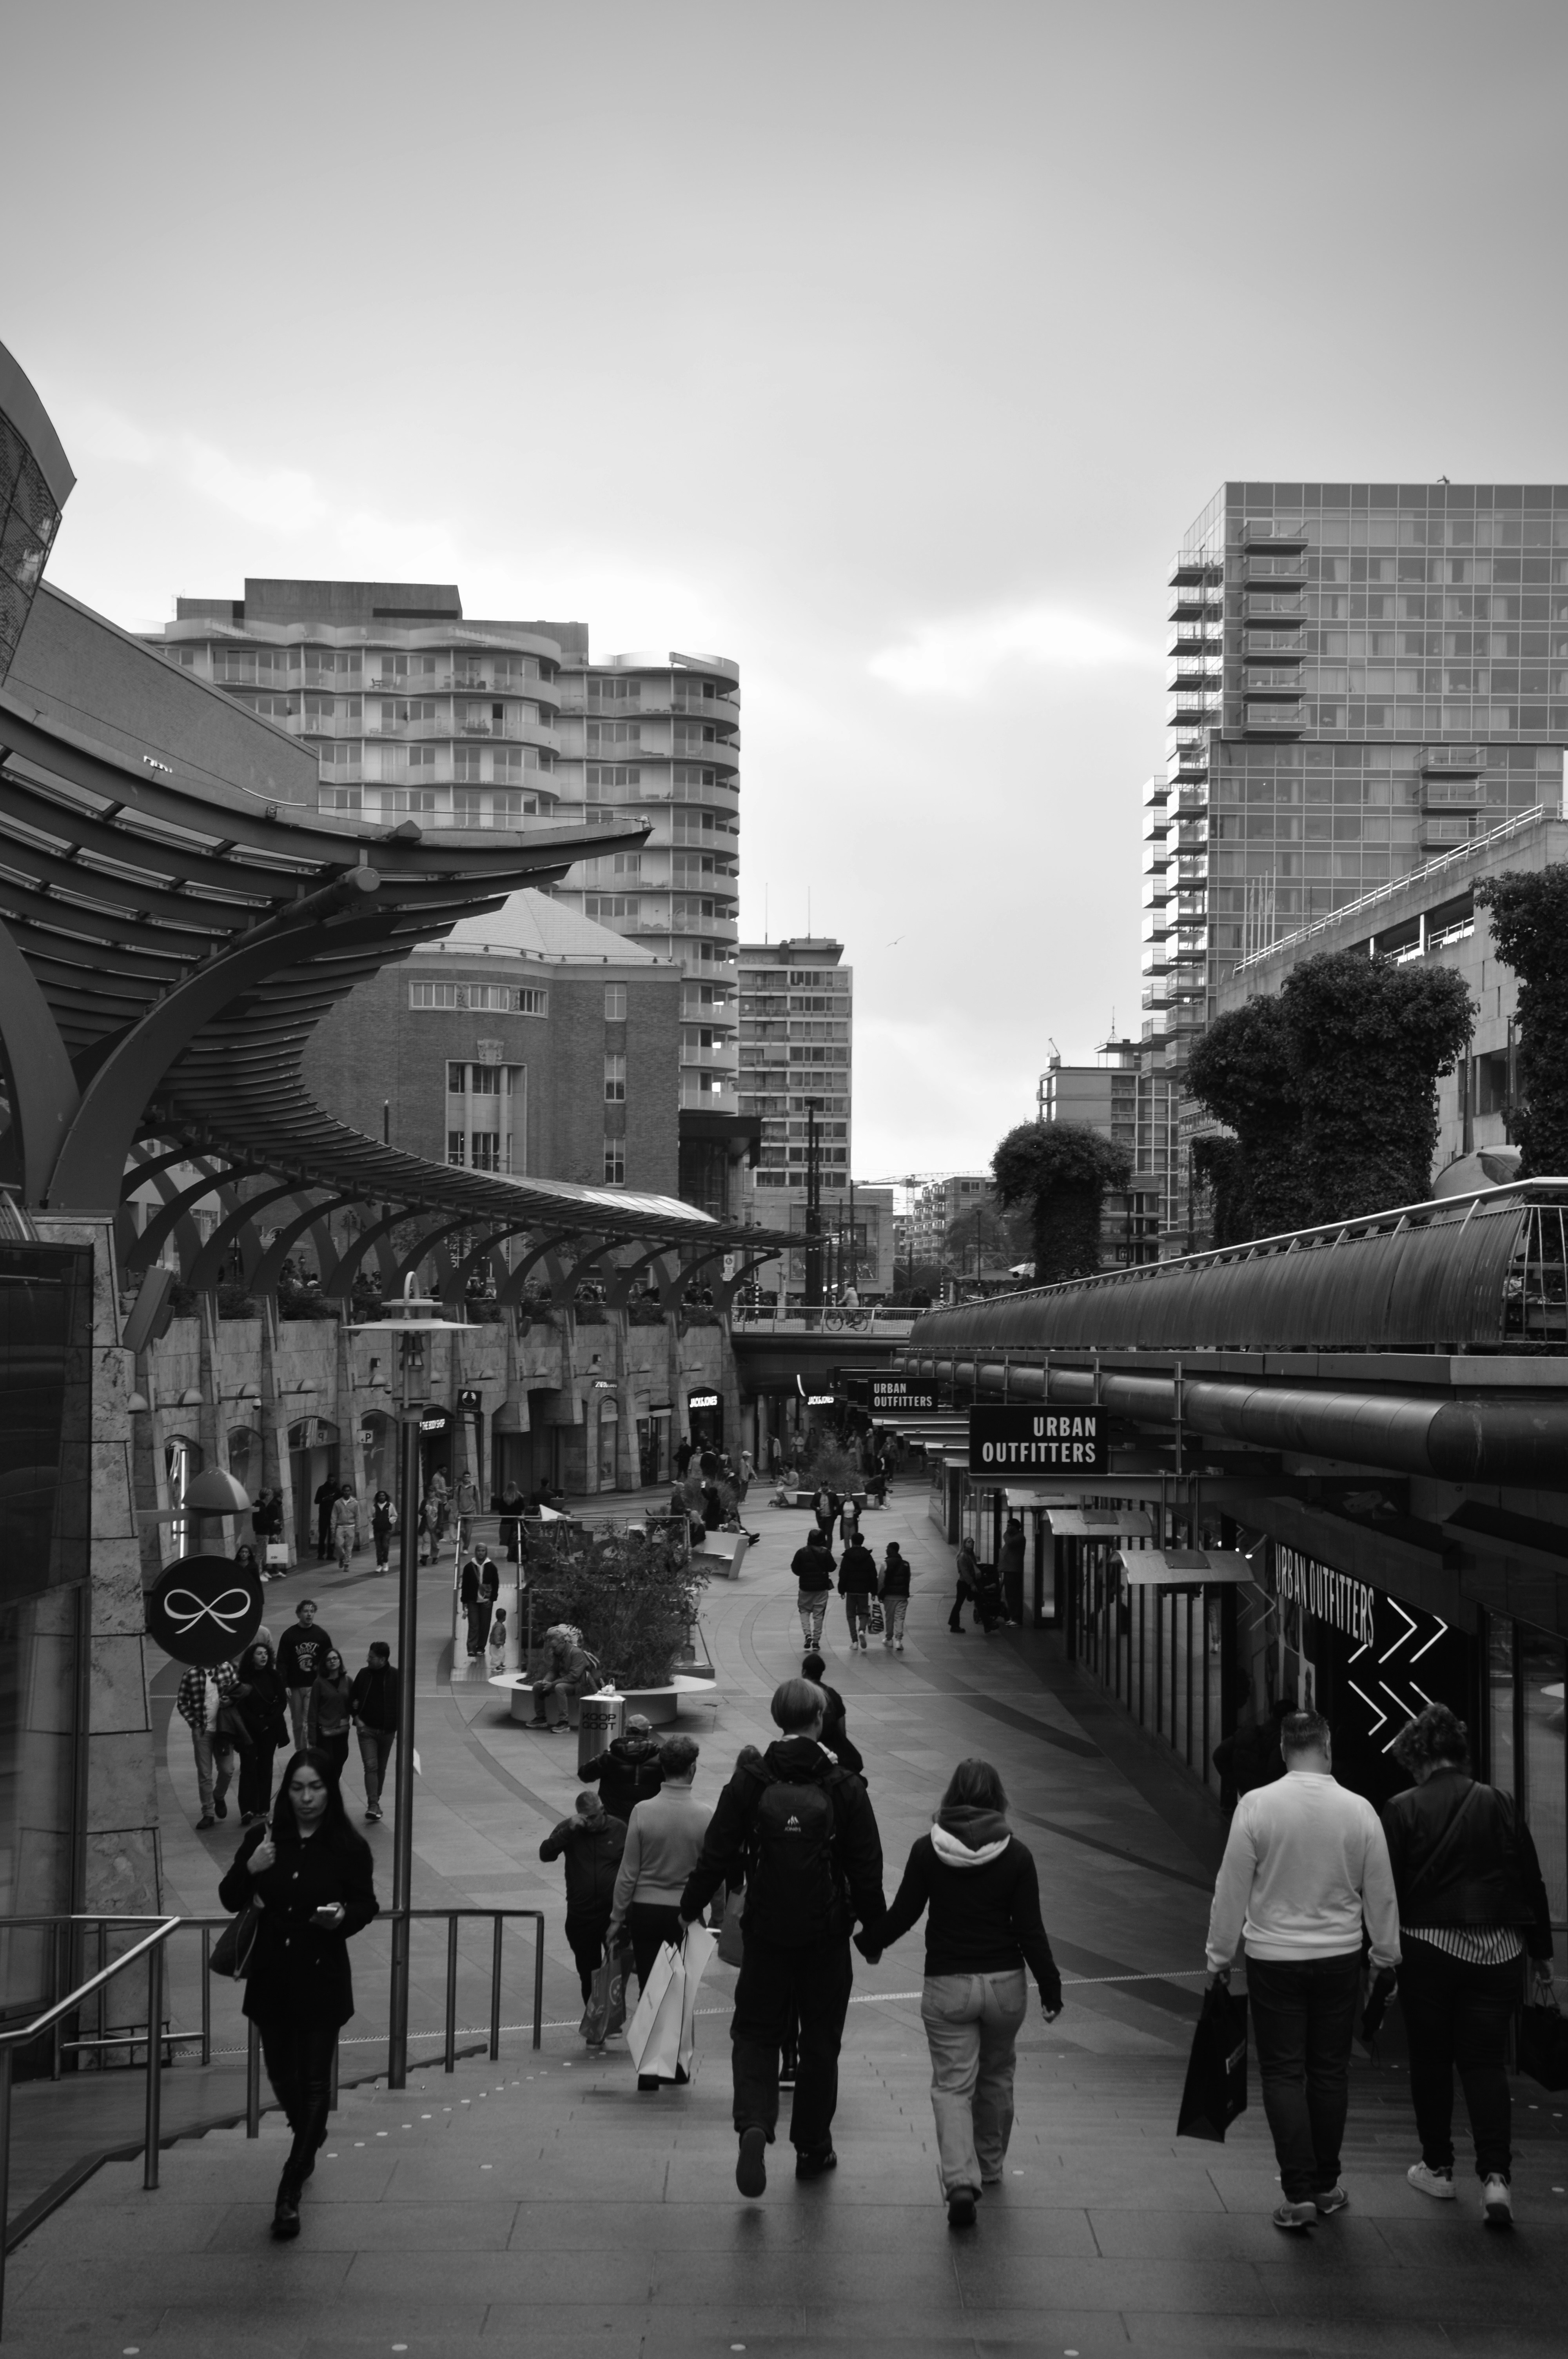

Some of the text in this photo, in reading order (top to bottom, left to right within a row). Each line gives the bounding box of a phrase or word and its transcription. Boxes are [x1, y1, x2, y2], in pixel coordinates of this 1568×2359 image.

[874, 1383, 906, 1394] URBAN
[874, 1396, 932, 1407] OUTFITTERS
[1033, 1416, 1096, 1437] URBAN
[365, 1433, 371, 1443] P
[982, 1442, 1096, 1463] OUTFITTERS
[1276, 1543, 1374, 1648] URBAN OUTFITTERS
[583, 1712, 616, 1721] KOOP
